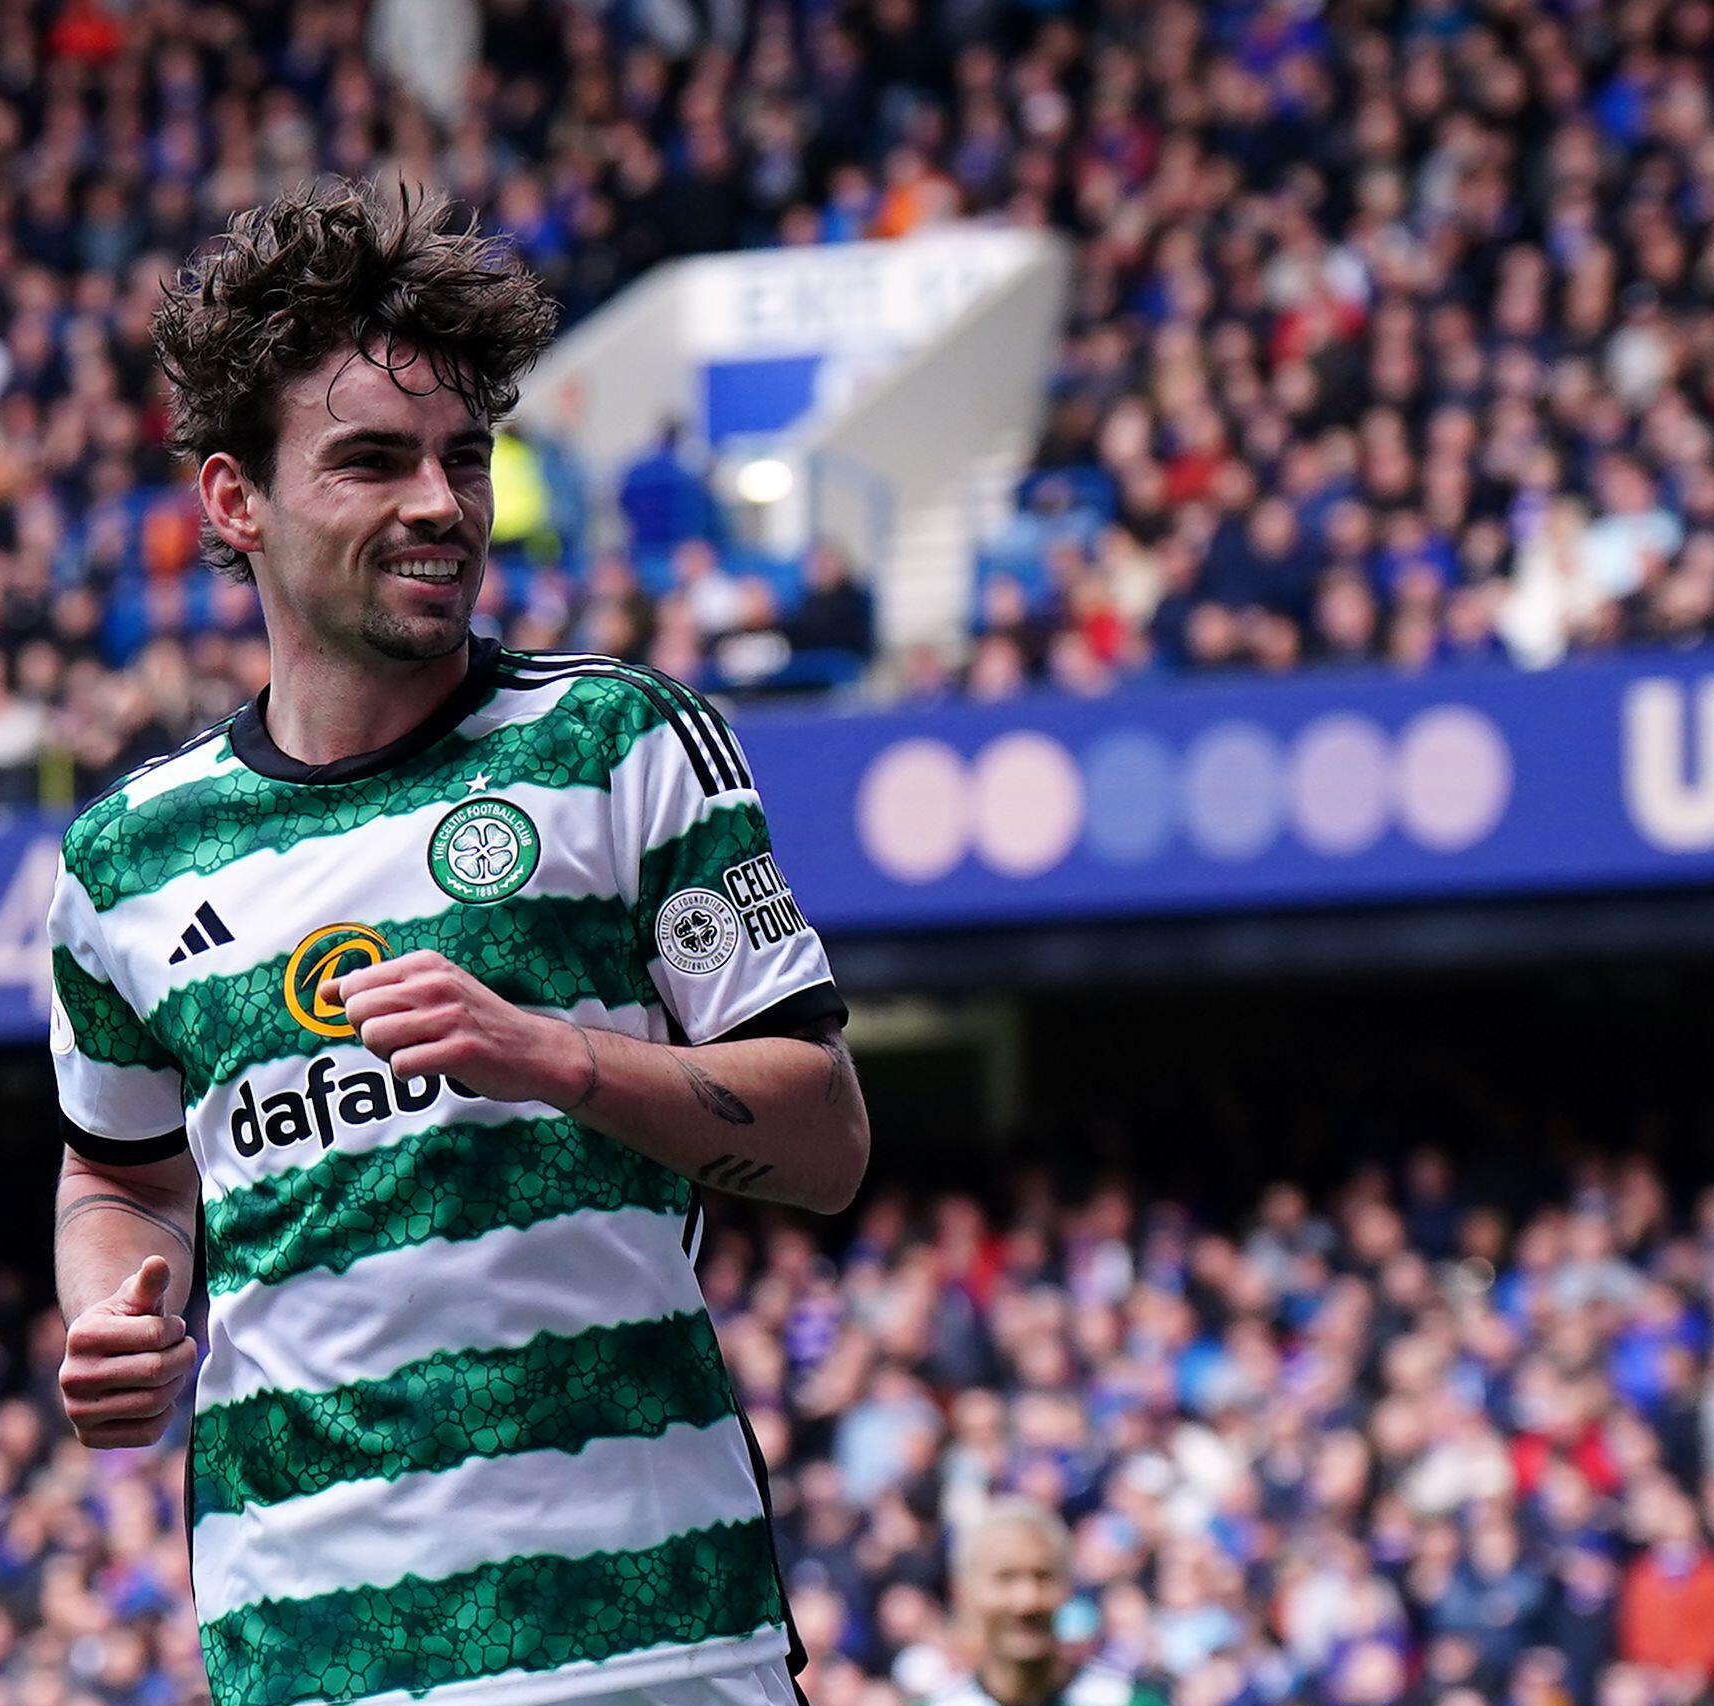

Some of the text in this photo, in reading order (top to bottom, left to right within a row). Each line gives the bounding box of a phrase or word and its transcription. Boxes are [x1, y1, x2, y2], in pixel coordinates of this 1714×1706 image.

[433, 804, 533, 861] THE CELTIC FOOTBALL CLUB
[726, 855, 789, 908] CELTI
[742, 894, 808, 951] FOUN
